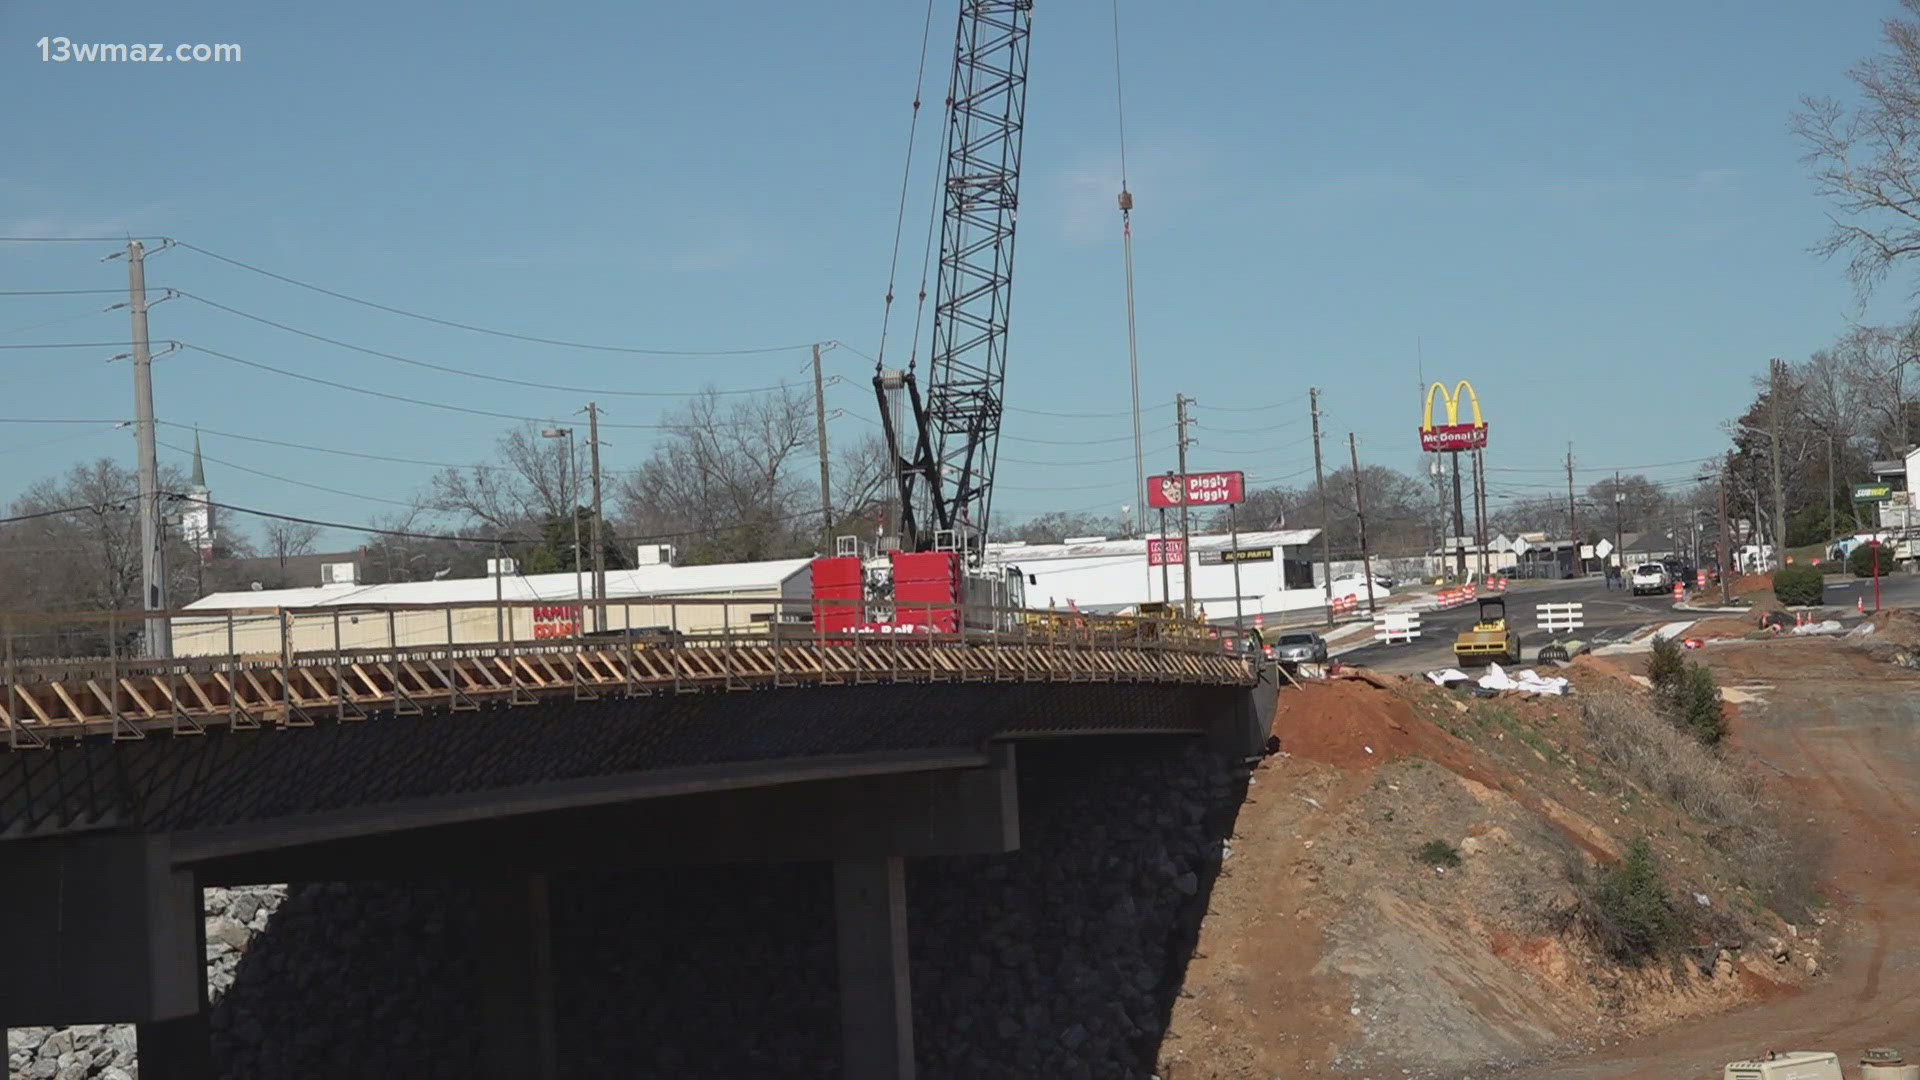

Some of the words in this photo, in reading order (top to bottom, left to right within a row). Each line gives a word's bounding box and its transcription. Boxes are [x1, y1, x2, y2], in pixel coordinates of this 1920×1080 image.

[1190, 475, 1228, 489] piggly
[1189, 488, 1229, 502] wiggly
[1855, 487, 1889, 497] SUBWAY
[1151, 552, 1182, 563] DOLAR
[1247, 550, 1271, 558] PARTS
